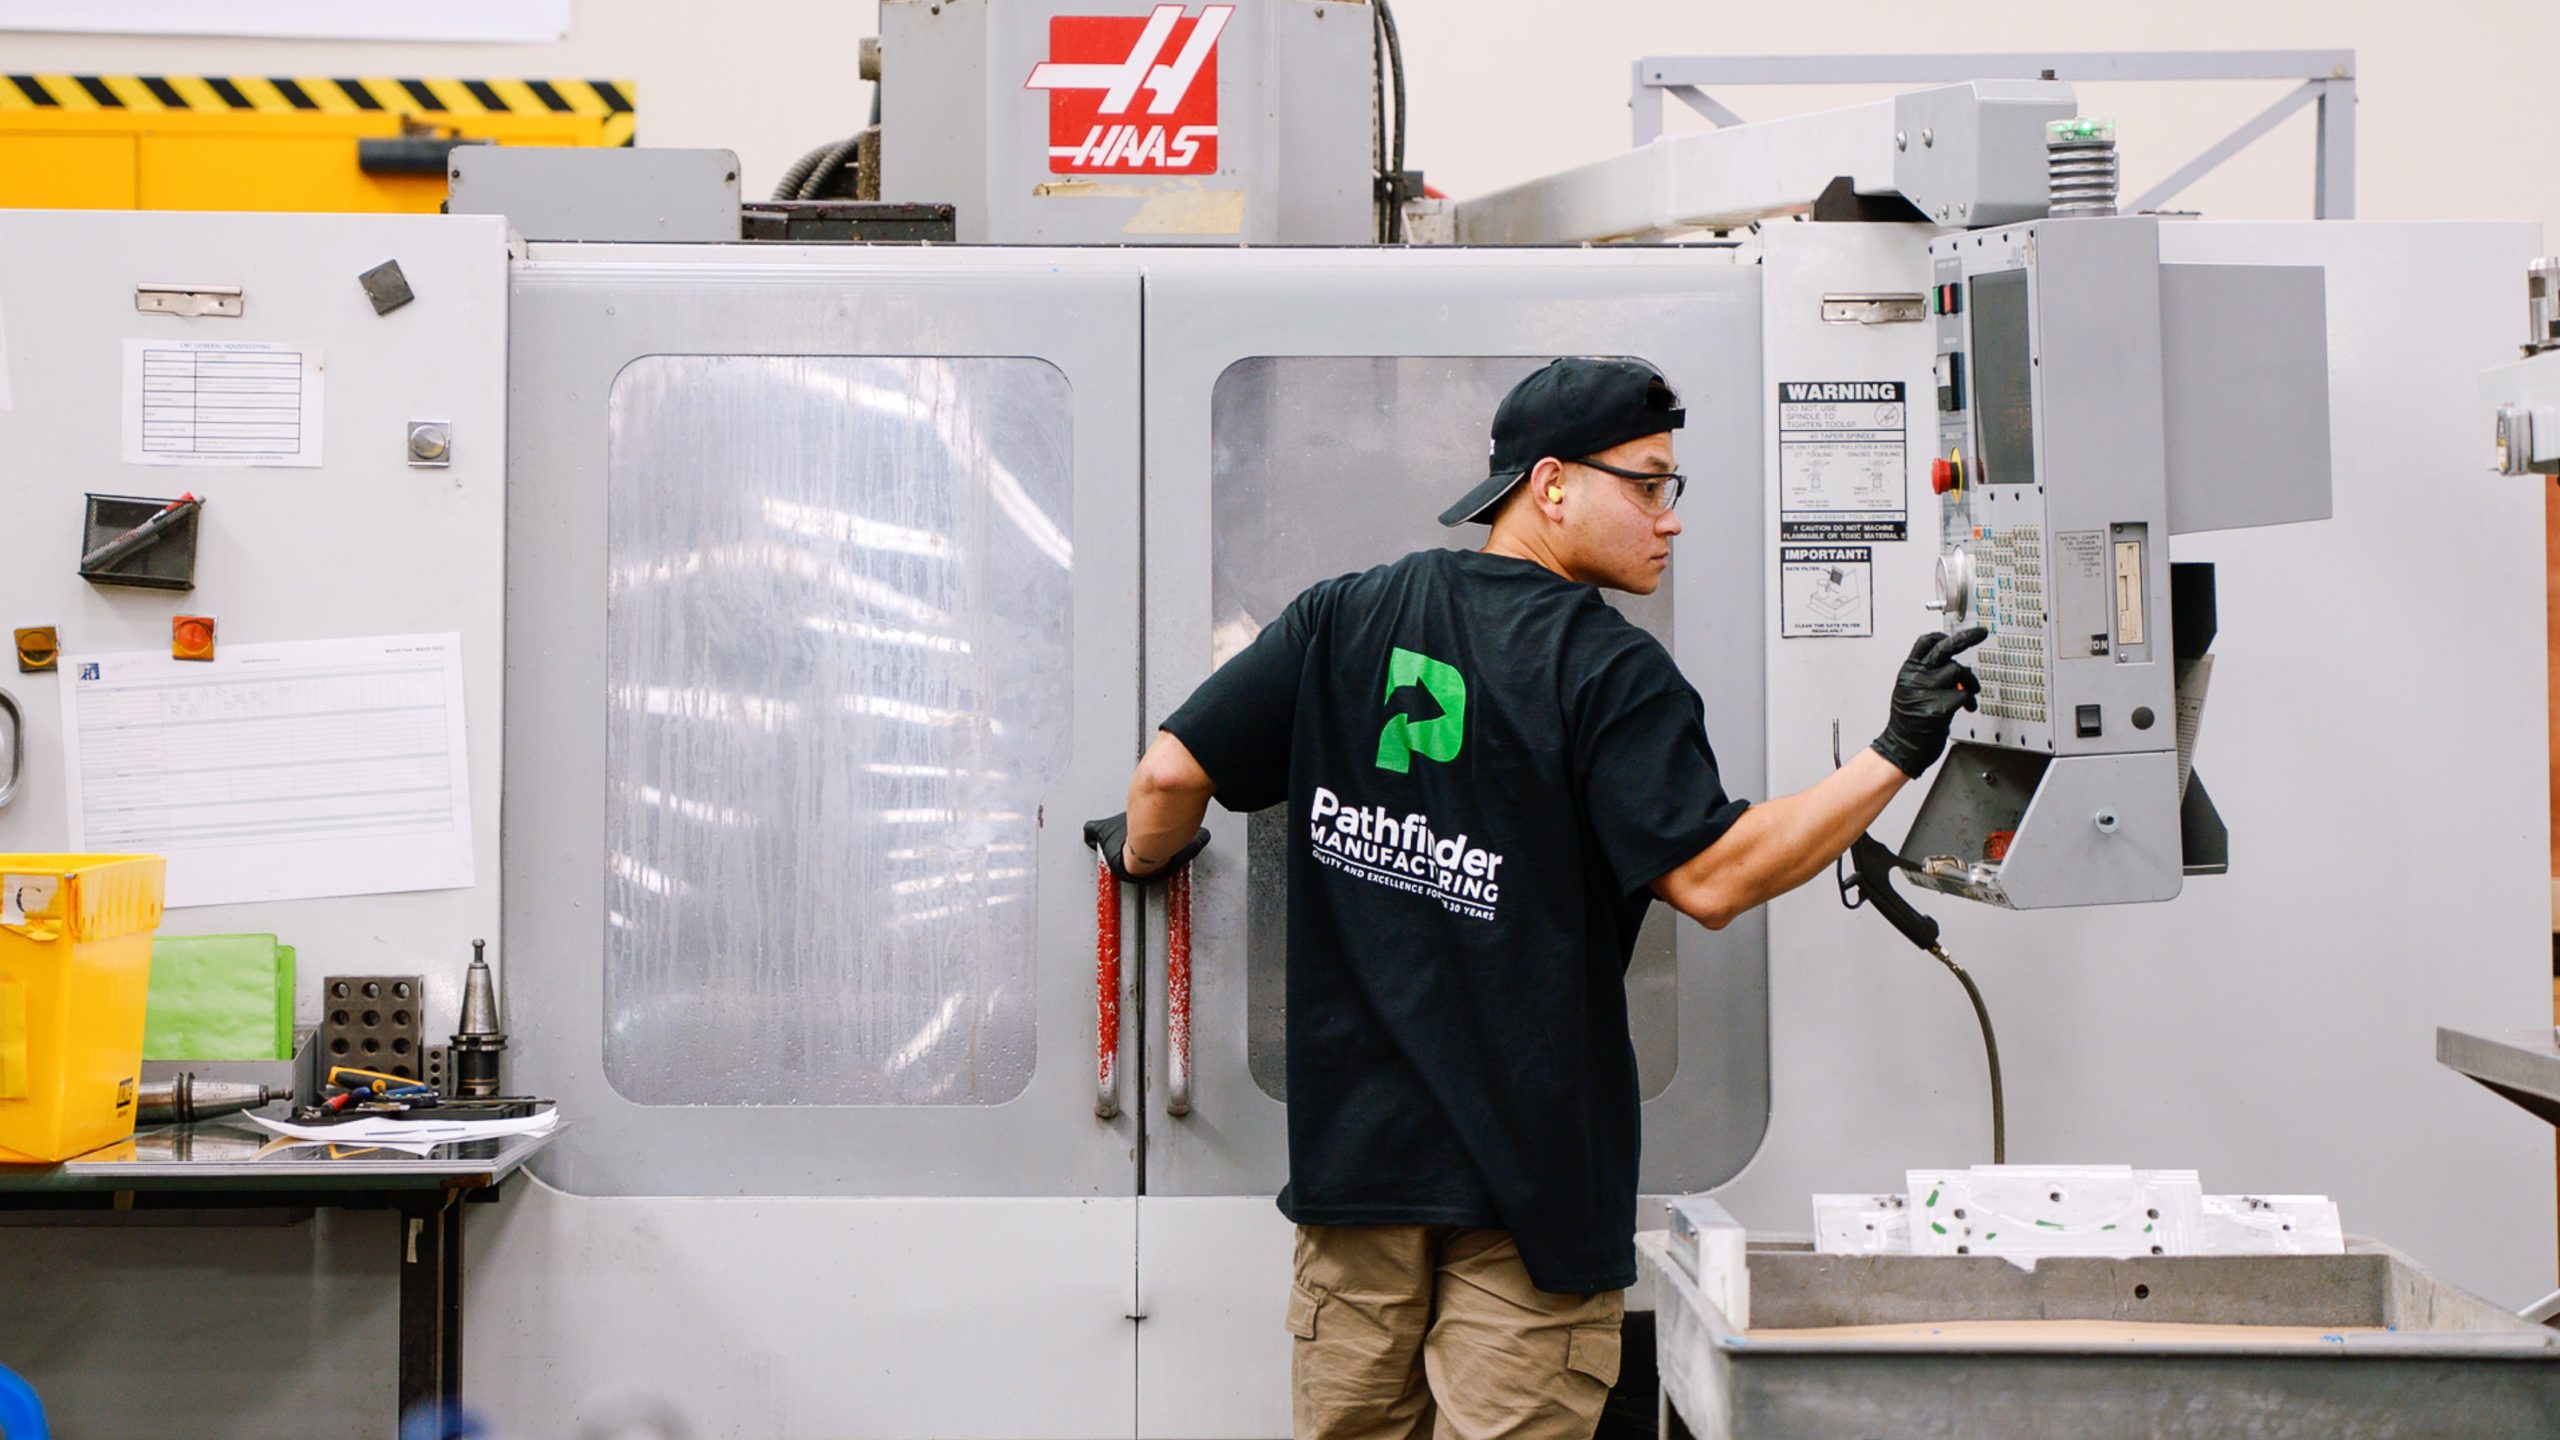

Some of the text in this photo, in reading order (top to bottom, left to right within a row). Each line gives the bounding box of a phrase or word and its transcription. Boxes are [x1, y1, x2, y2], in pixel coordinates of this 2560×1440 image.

[1049, 124, 1218, 167] HAAS
[1787, 383, 1896, 401] WARNING
[1785, 549, 1868, 560] IMPORTANT!
[1311, 822, 1500, 904] MANUFACTRING
[1312, 849, 1344, 869] QLITY
[1343, 865, 1365, 879] AND
[1366, 872, 1424, 895] EXCELLENCE
[1449, 902, 1462, 914] 30
[1463, 906, 1496, 921] YEARS
